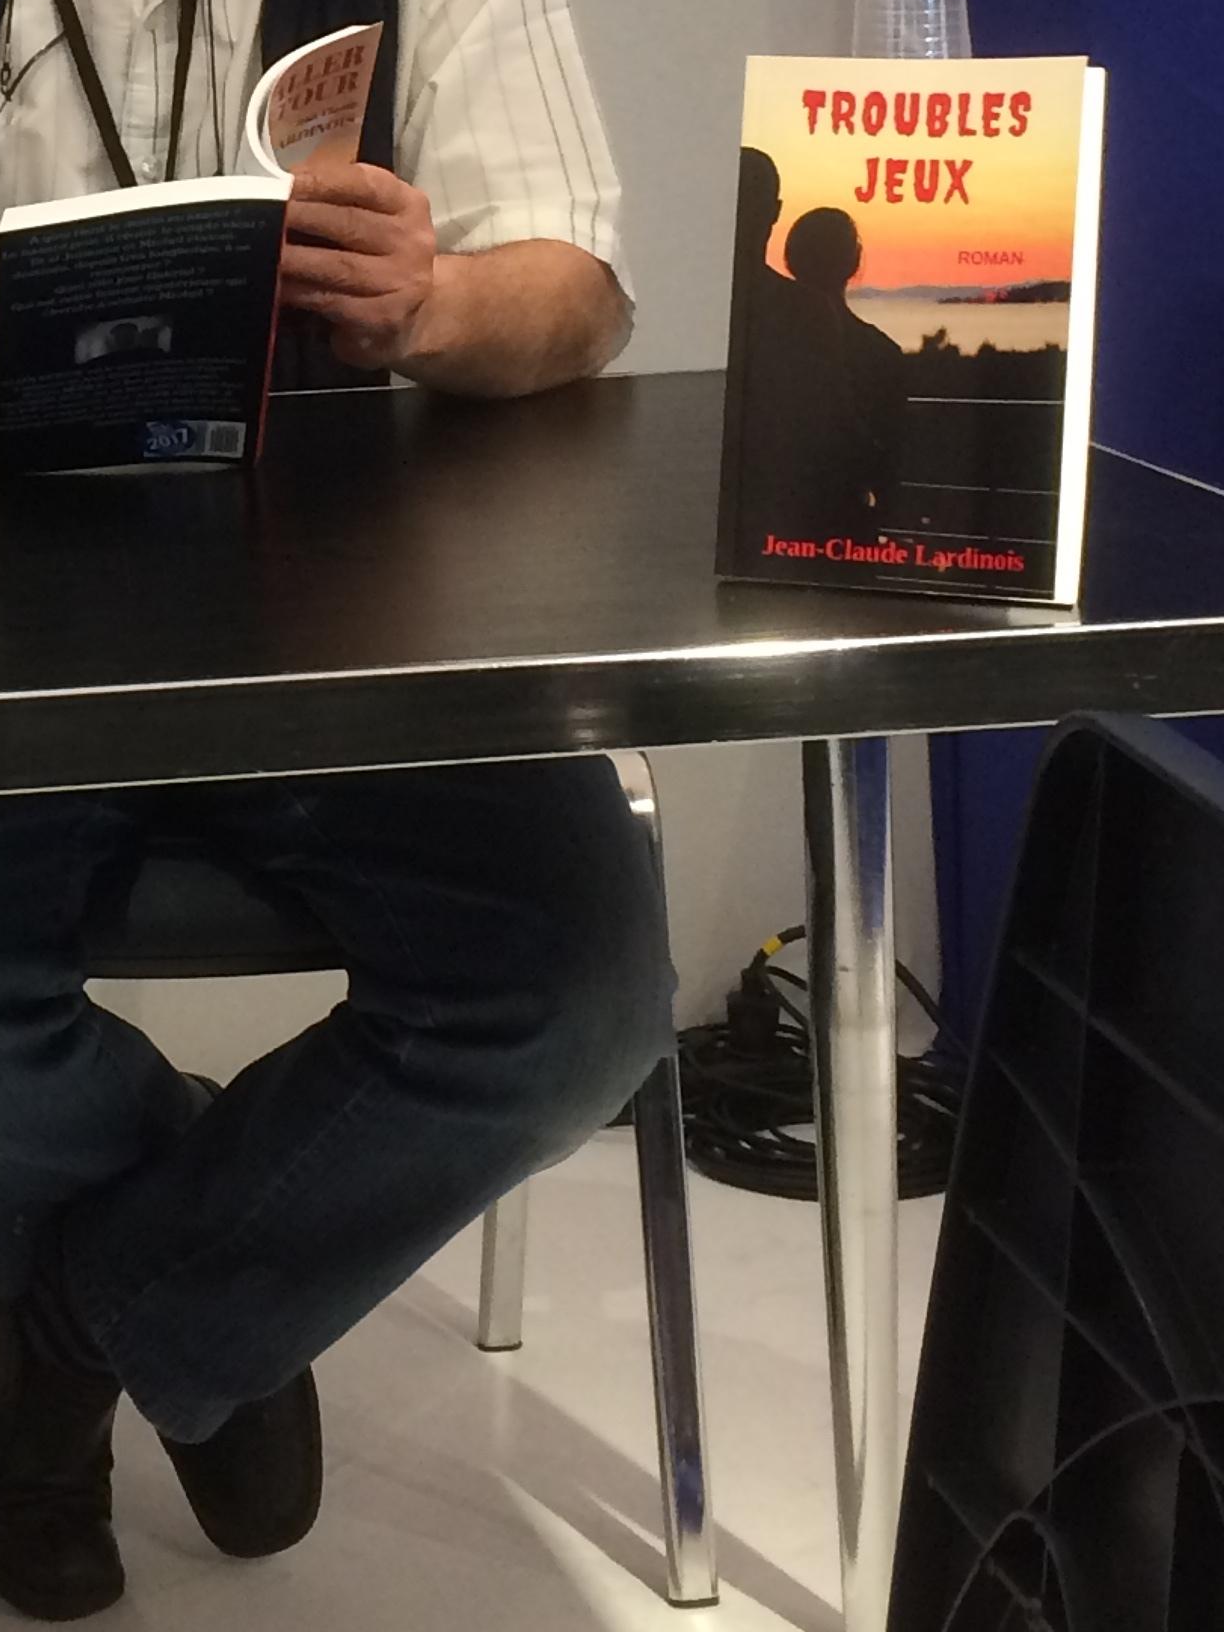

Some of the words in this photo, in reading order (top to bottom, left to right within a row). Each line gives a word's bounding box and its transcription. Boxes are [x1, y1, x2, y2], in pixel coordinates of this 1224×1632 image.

[802, 89, 1032, 138] TROUBLES
[854, 156, 974, 205] JEUX
[957, 250, 1025, 266] ROMAN
[762, 534, 909, 565] Jean-Claude
[915, 543, 1025, 571] Lardinois
